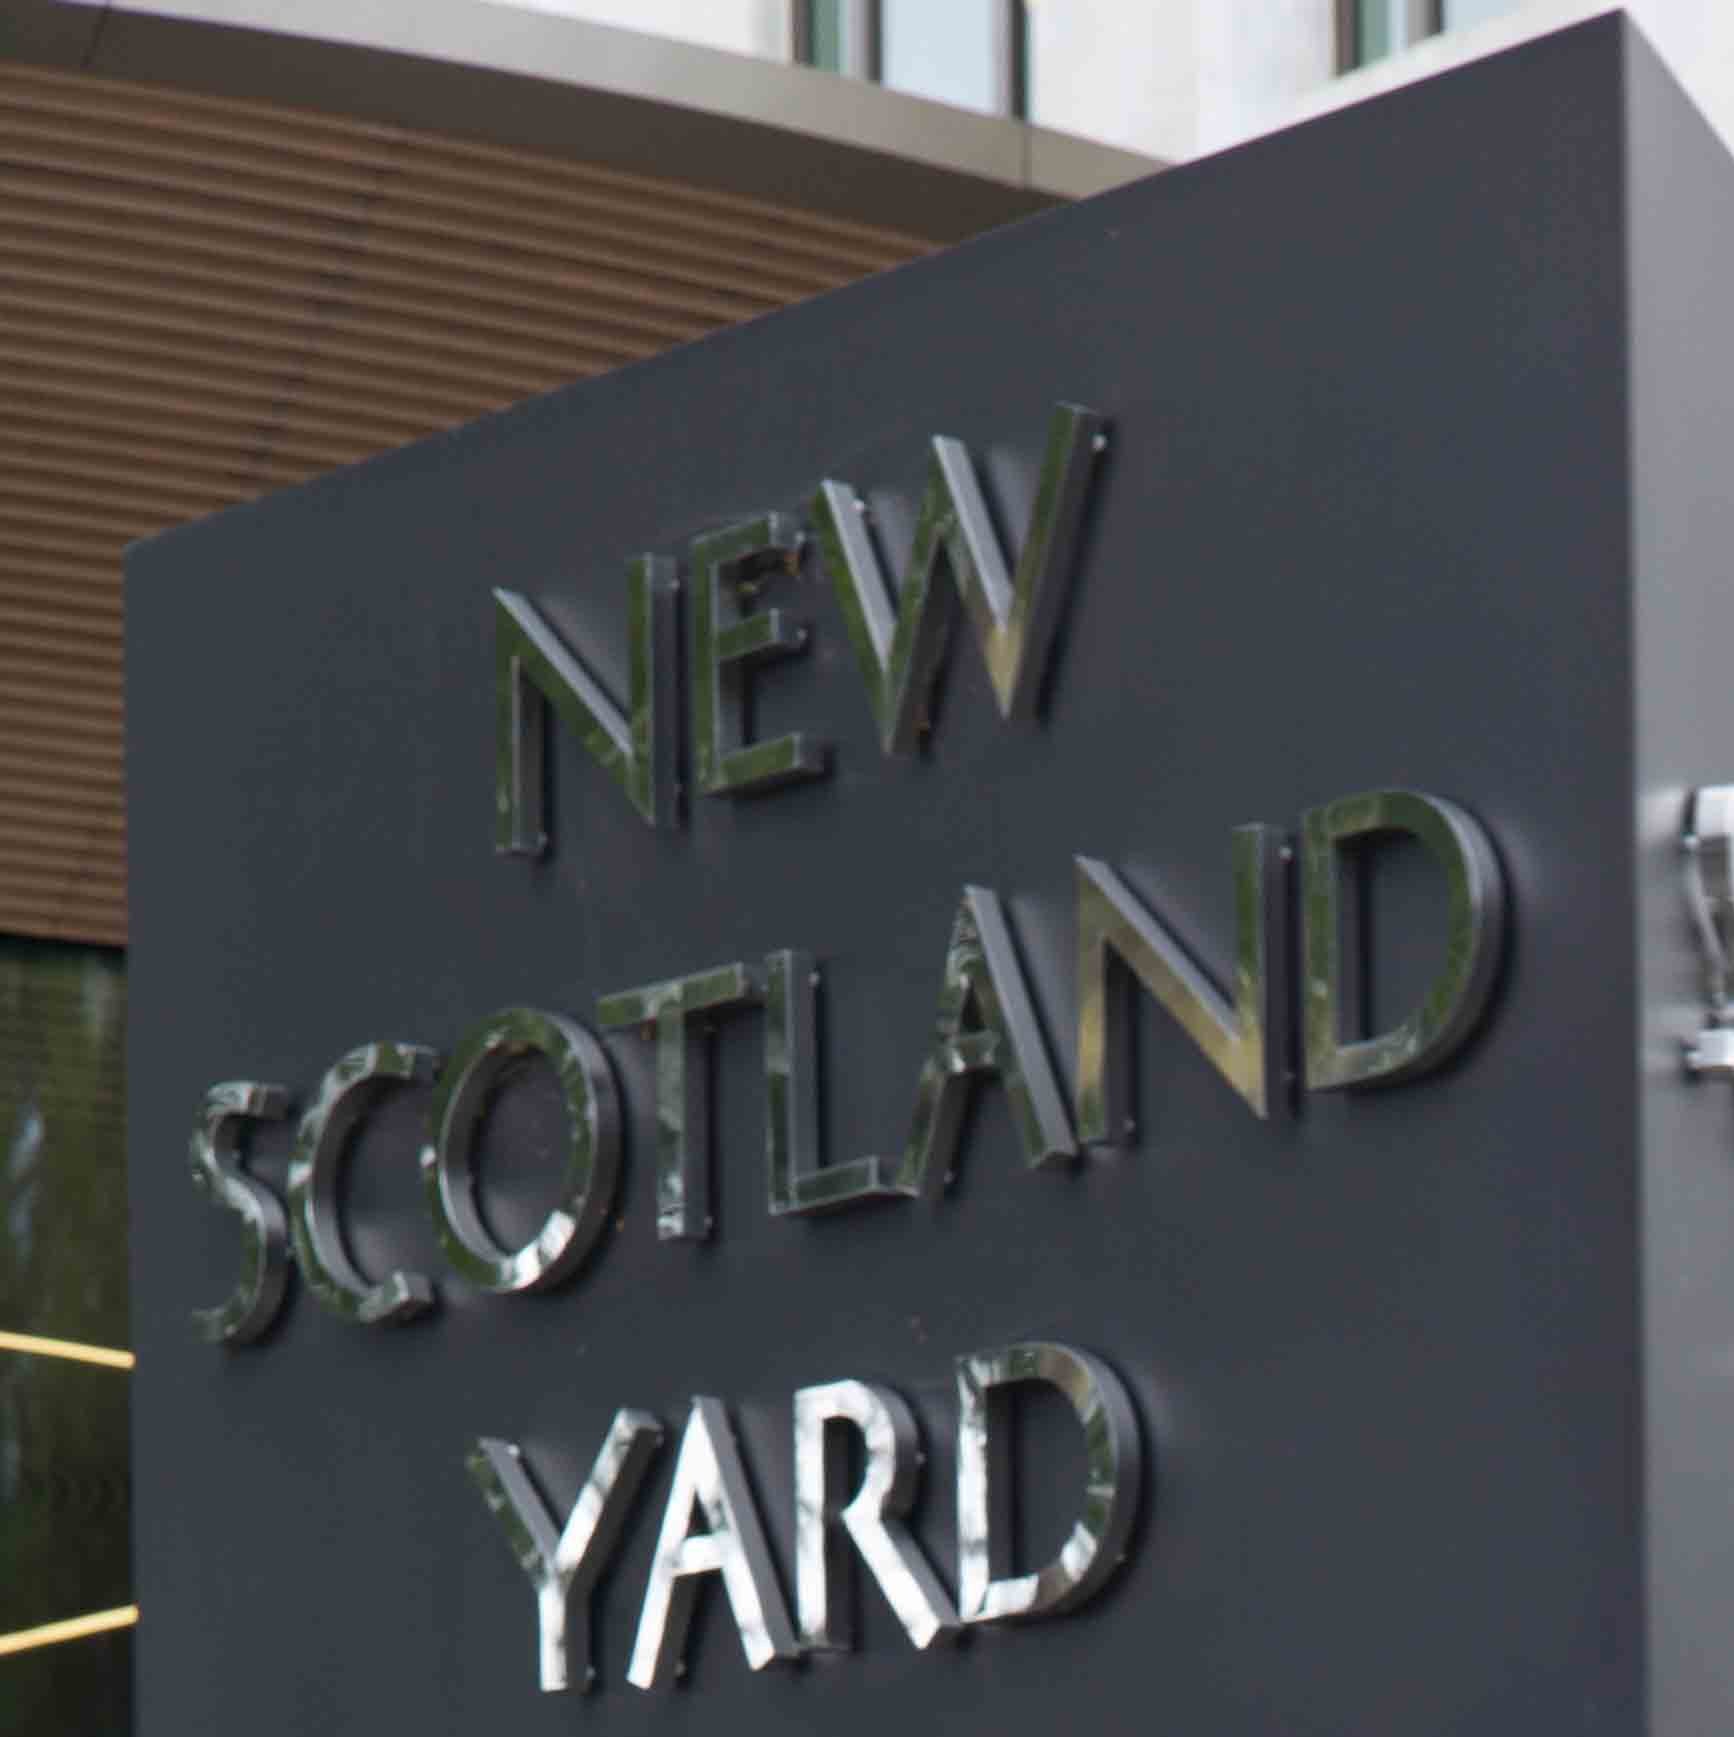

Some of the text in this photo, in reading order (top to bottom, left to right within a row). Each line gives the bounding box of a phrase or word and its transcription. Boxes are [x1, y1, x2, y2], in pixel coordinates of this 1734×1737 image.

[493, 400, 1108, 856] NEW
[190, 788, 1505, 1346] SCOTLAND
[470, 1342, 1144, 1693] YARD
